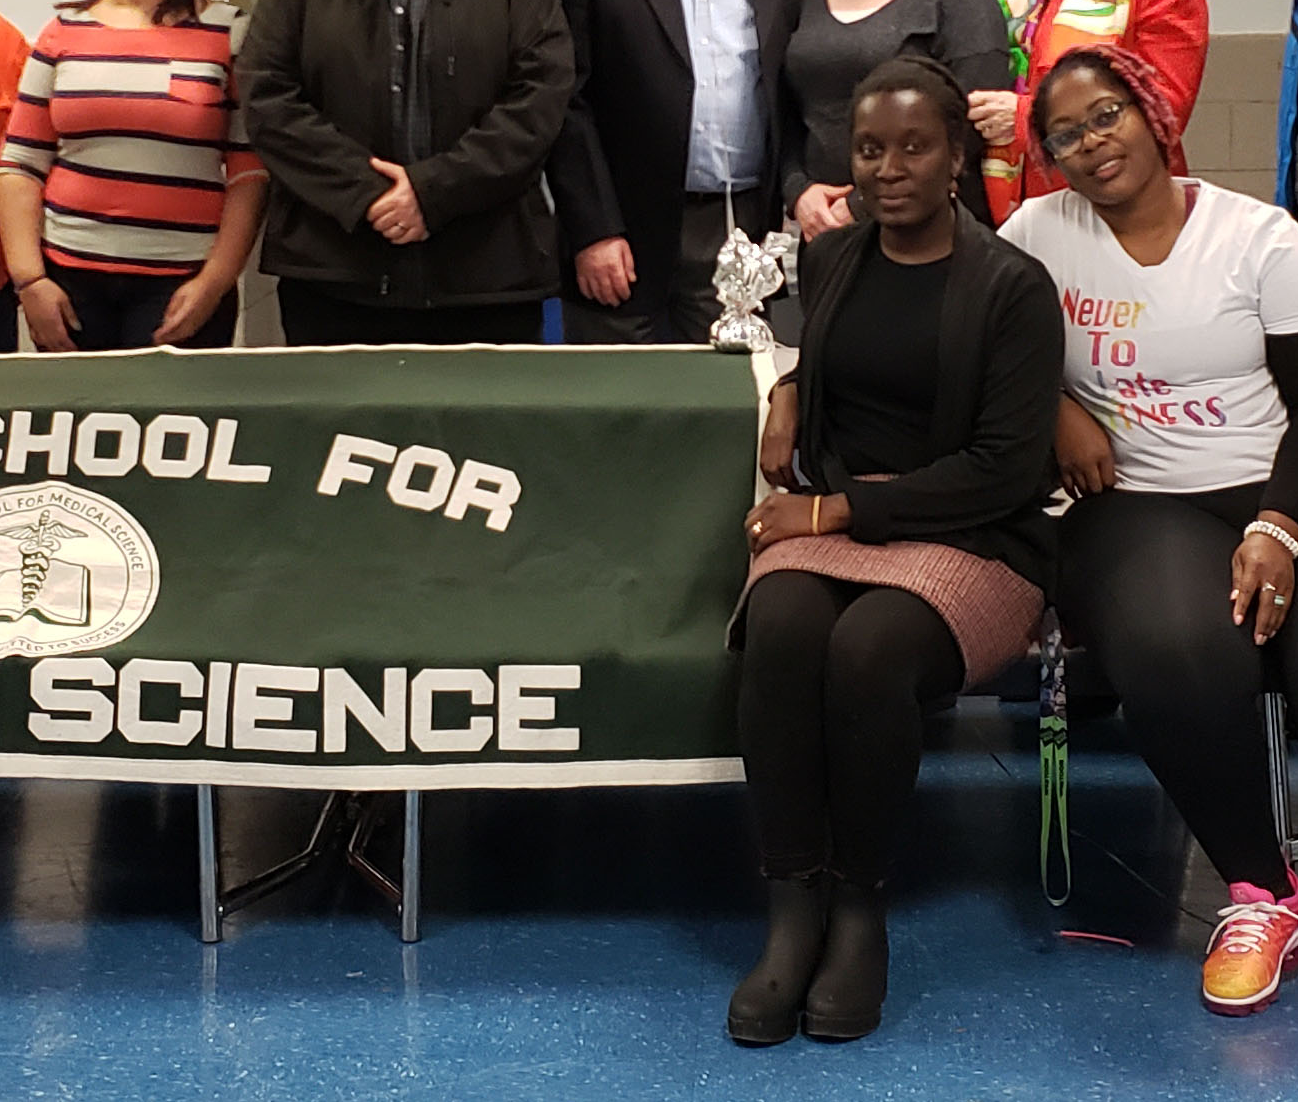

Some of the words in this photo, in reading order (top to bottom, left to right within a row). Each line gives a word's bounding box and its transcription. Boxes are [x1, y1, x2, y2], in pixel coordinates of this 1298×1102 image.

[1061, 286, 1147, 328] Never
[1087, 330, 1136, 367] To
[316, 433, 523, 533] FOR
[17, 493, 46, 510] FOR
[49, 492, 112, 529] MEDICAL
[110, 523, 145, 572] SCIENCE
[27, 656, 582, 754] SCIENCE
